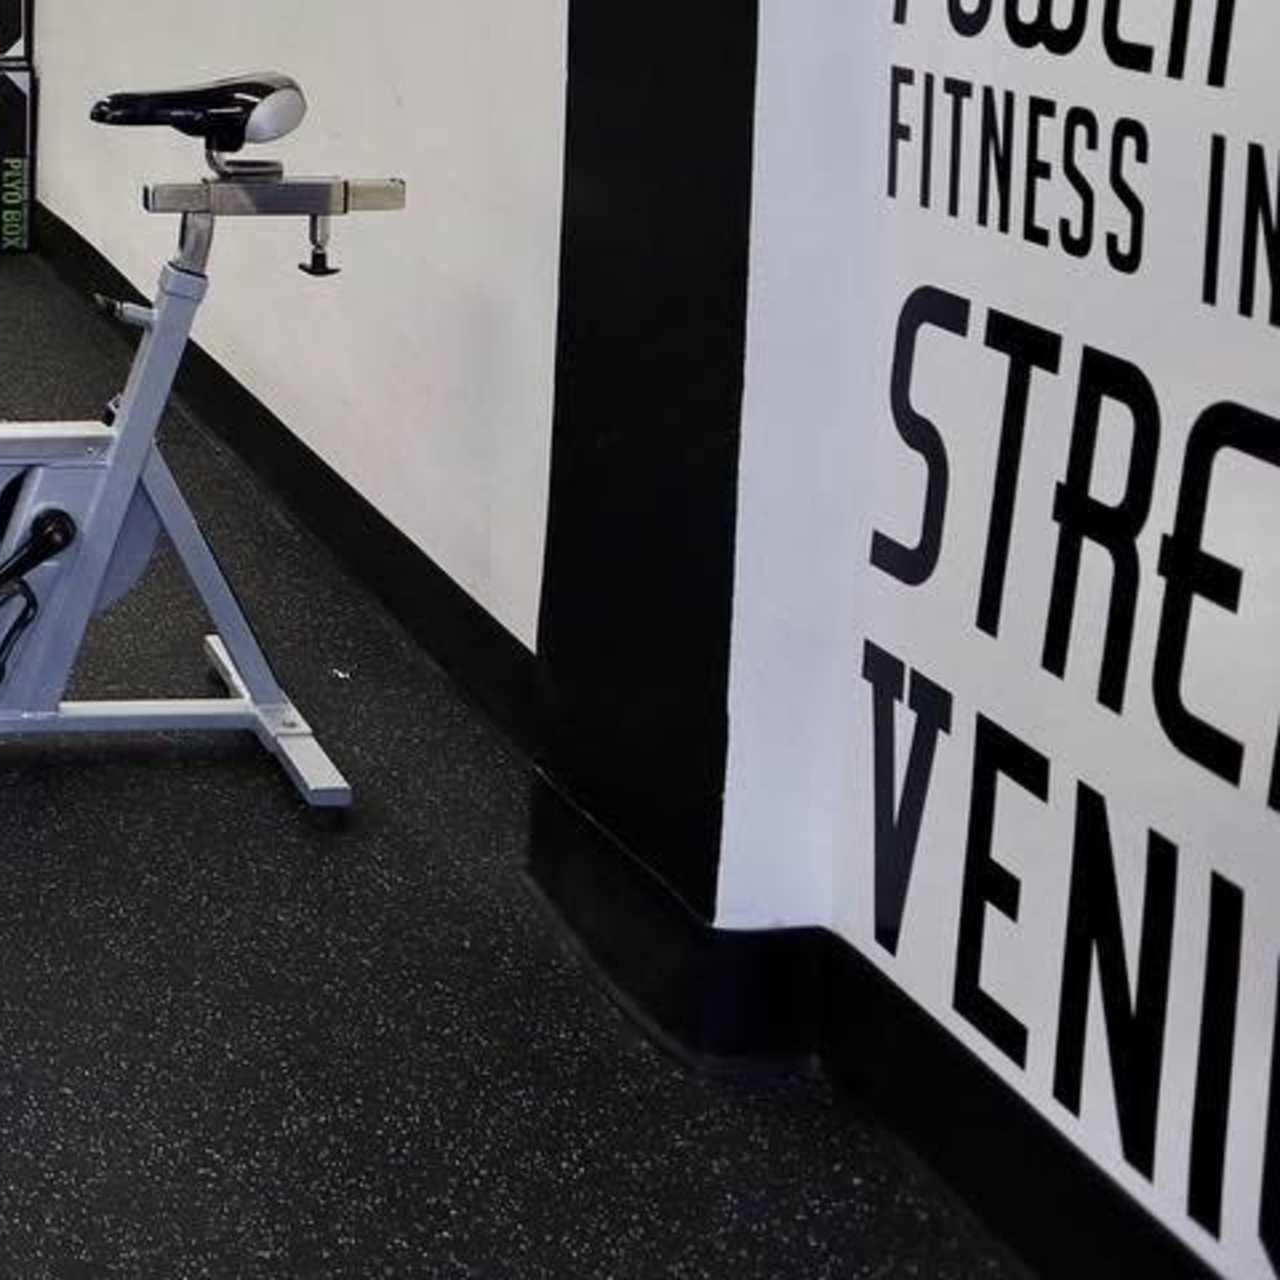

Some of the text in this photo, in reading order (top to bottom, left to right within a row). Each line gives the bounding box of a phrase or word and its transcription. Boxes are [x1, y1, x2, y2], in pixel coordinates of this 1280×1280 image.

[2, 157, 23, 248] PLYO BOX
[887, 65, 1280, 329] FITNESS IN
